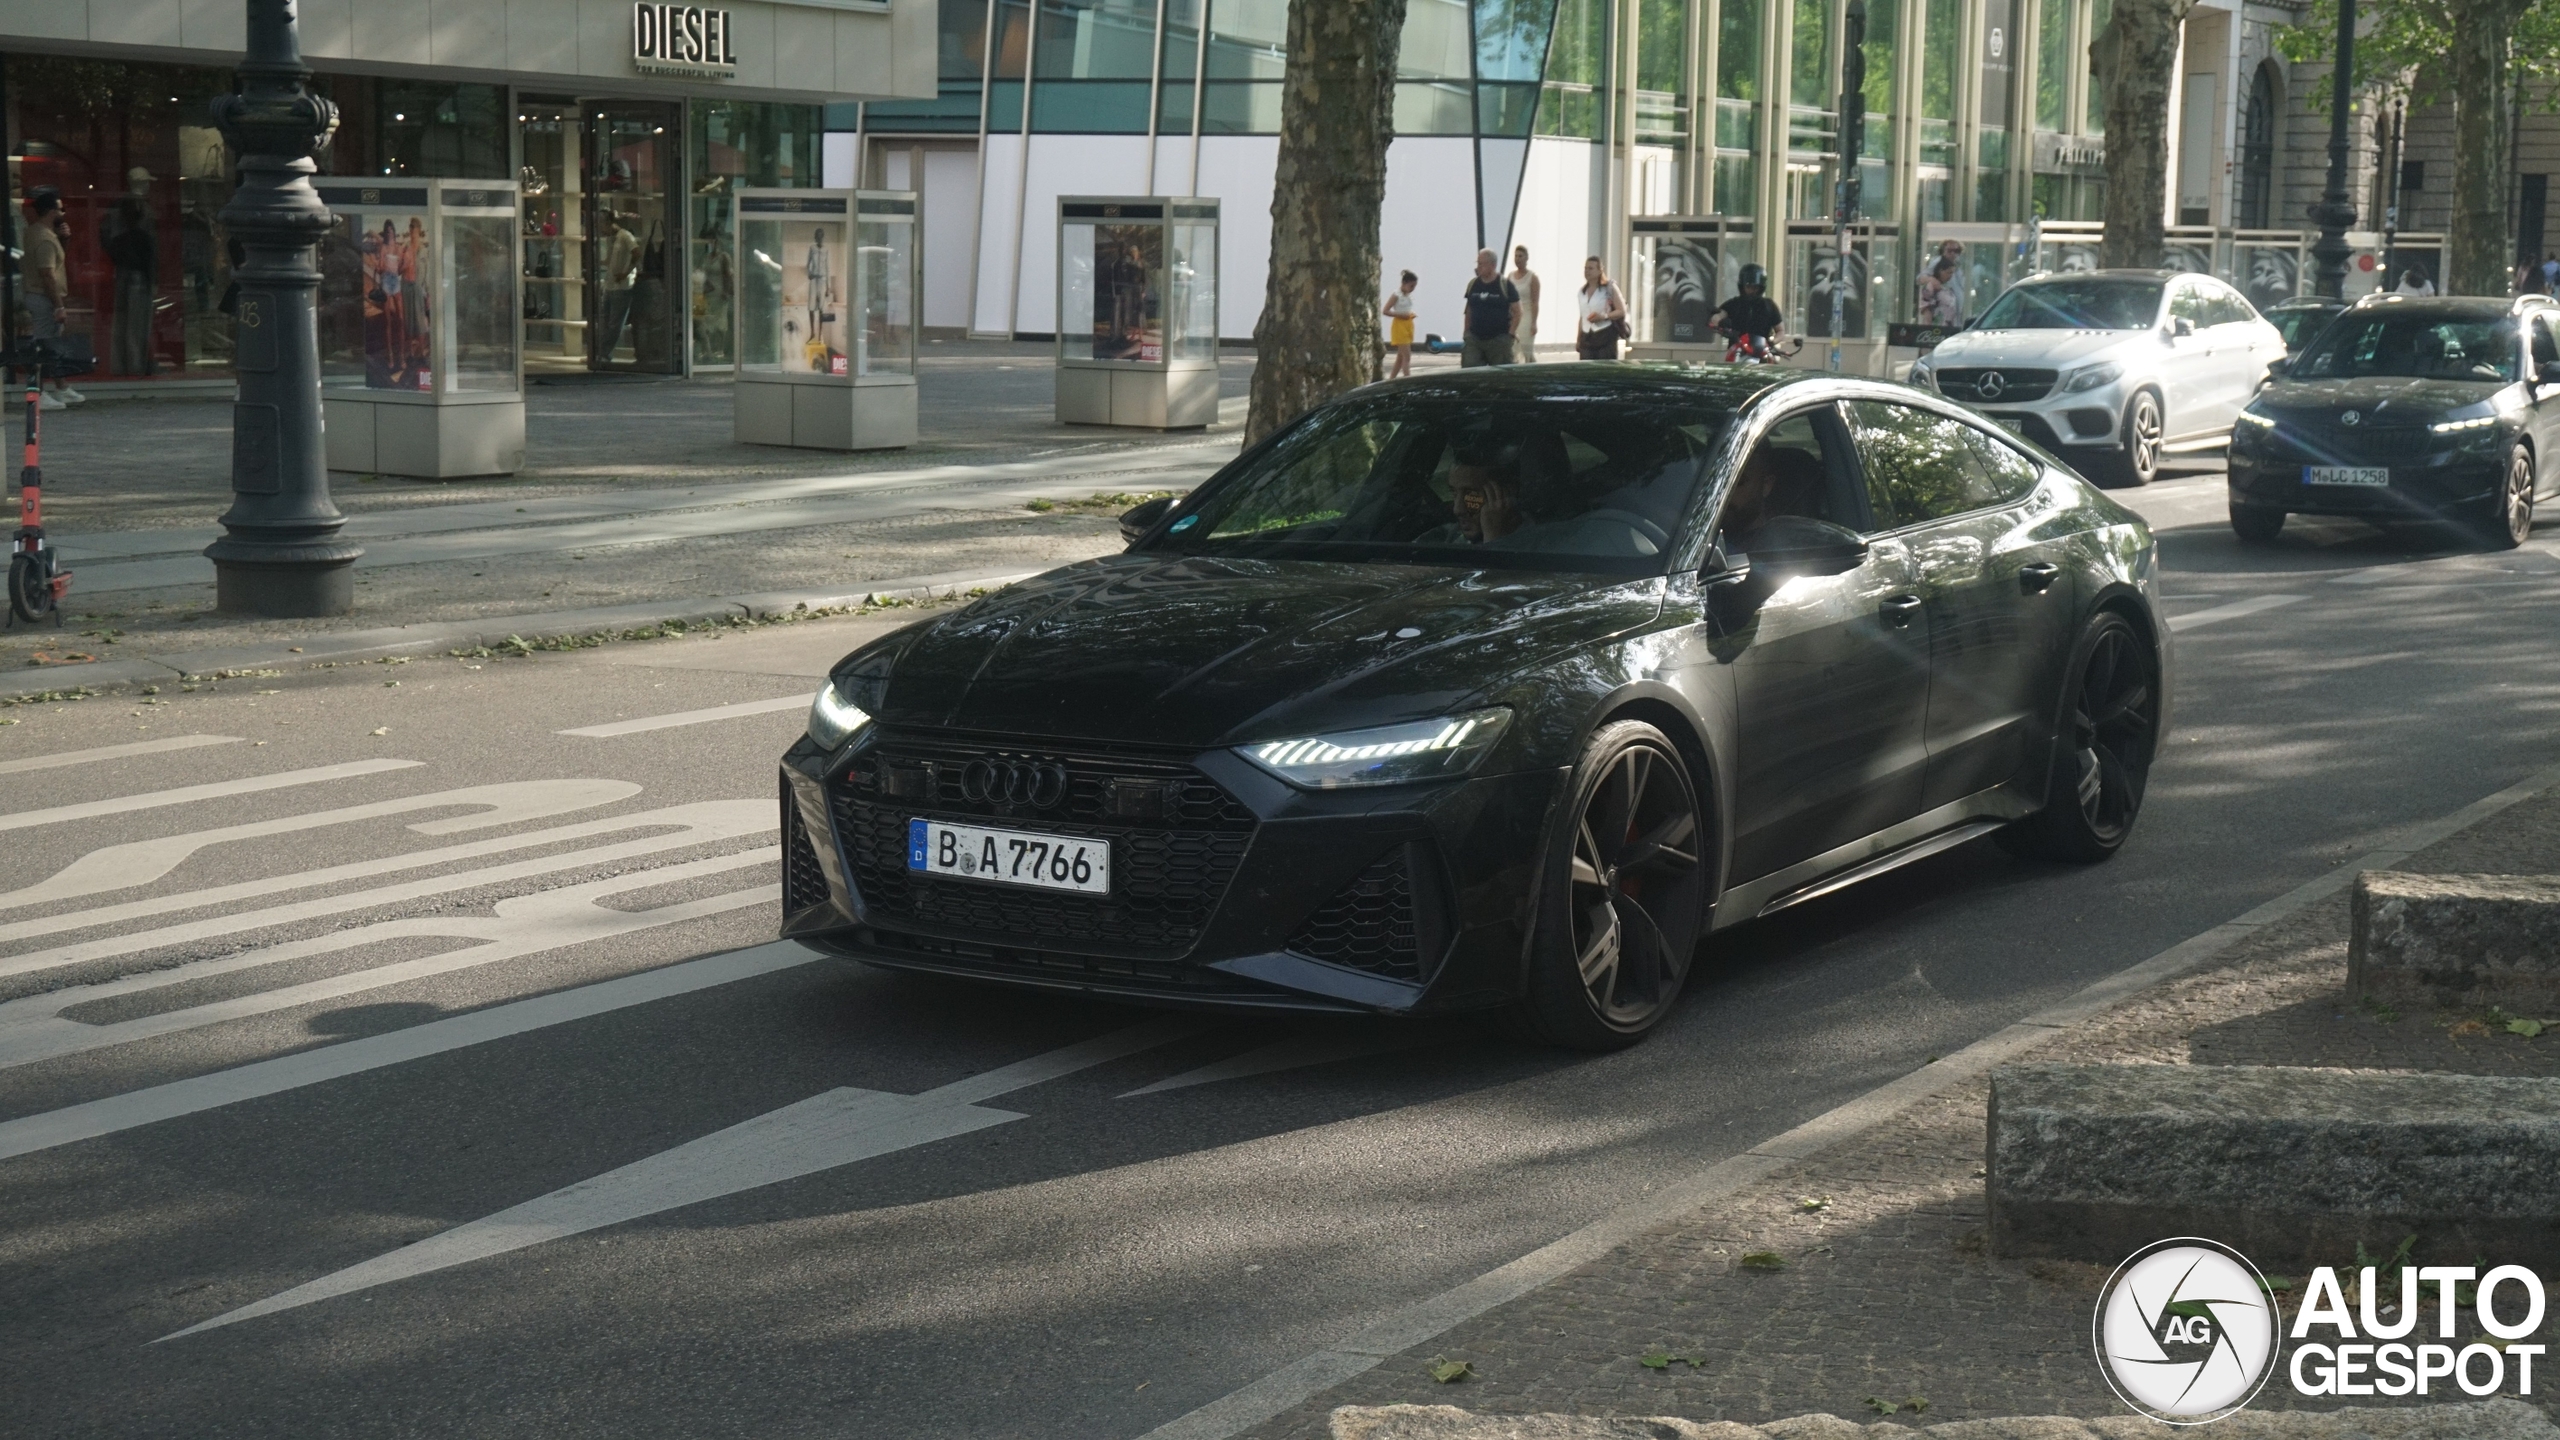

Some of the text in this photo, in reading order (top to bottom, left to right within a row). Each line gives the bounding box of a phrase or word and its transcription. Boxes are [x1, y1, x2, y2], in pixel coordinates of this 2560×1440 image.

[635, 2, 737, 66] DIESEL
[636, 65, 735, 78] FOR SUCCESSFUL LIVING
[2312, 469, 2386, 483] M LC 1258
[939, 830, 1092, 884] B A 7766
